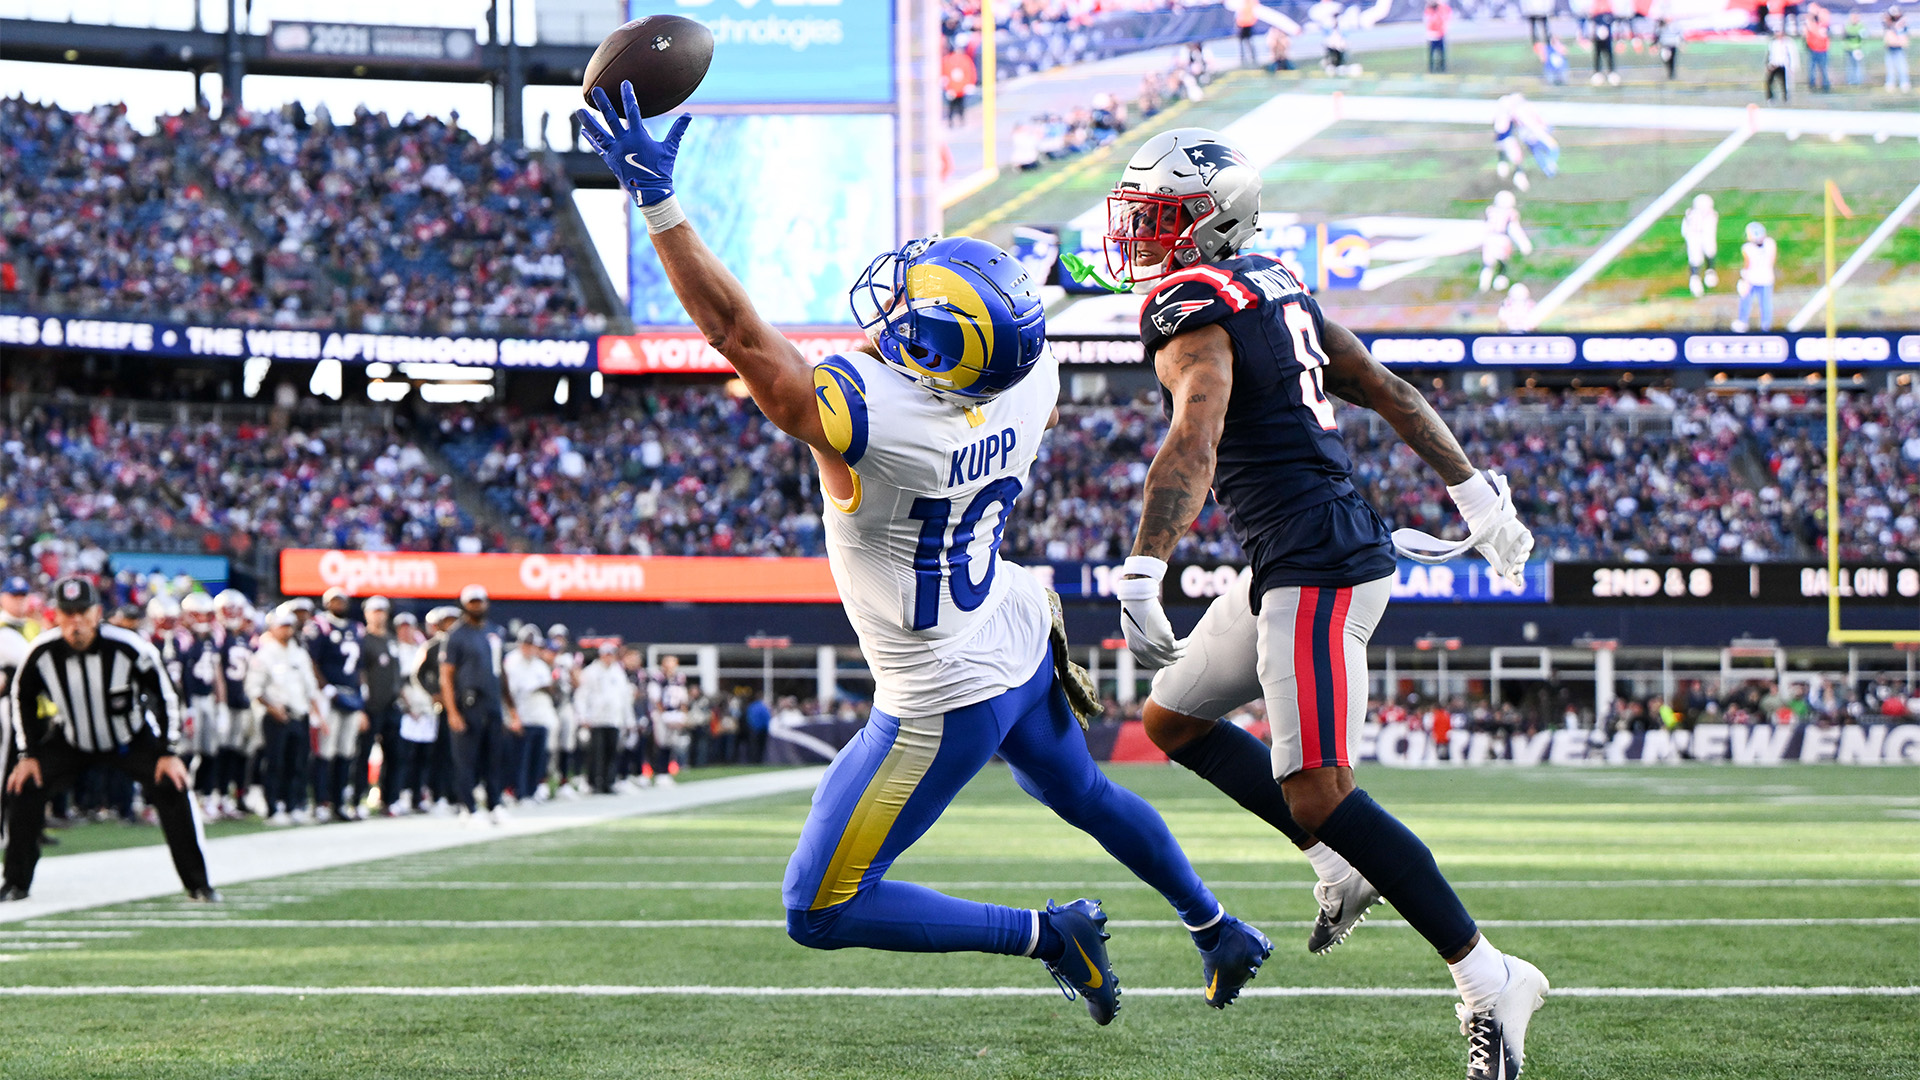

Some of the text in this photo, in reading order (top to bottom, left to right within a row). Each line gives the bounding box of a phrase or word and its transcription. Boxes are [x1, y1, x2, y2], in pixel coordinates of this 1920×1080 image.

[678, 12, 843, 52] chnologies
[66, 319, 154, 351] KEEFE
[186, 326, 243, 356] THE
[322, 332, 498, 365] AFTERNOON
[499, 338, 590, 367] SHOW
[1283, 302, 1338, 431] 0
[948, 427, 1016, 488] KUPP
[319, 551, 437, 595] Optum
[908, 476, 1023, 631] 10
[520, 555, 645, 598] Optum
[1391, 565, 1455, 597] LAR
[1593, 567, 1712, 597] 2ND & 8
[1854, 567, 1888, 597] ON
[340, 642, 360, 675] 7
